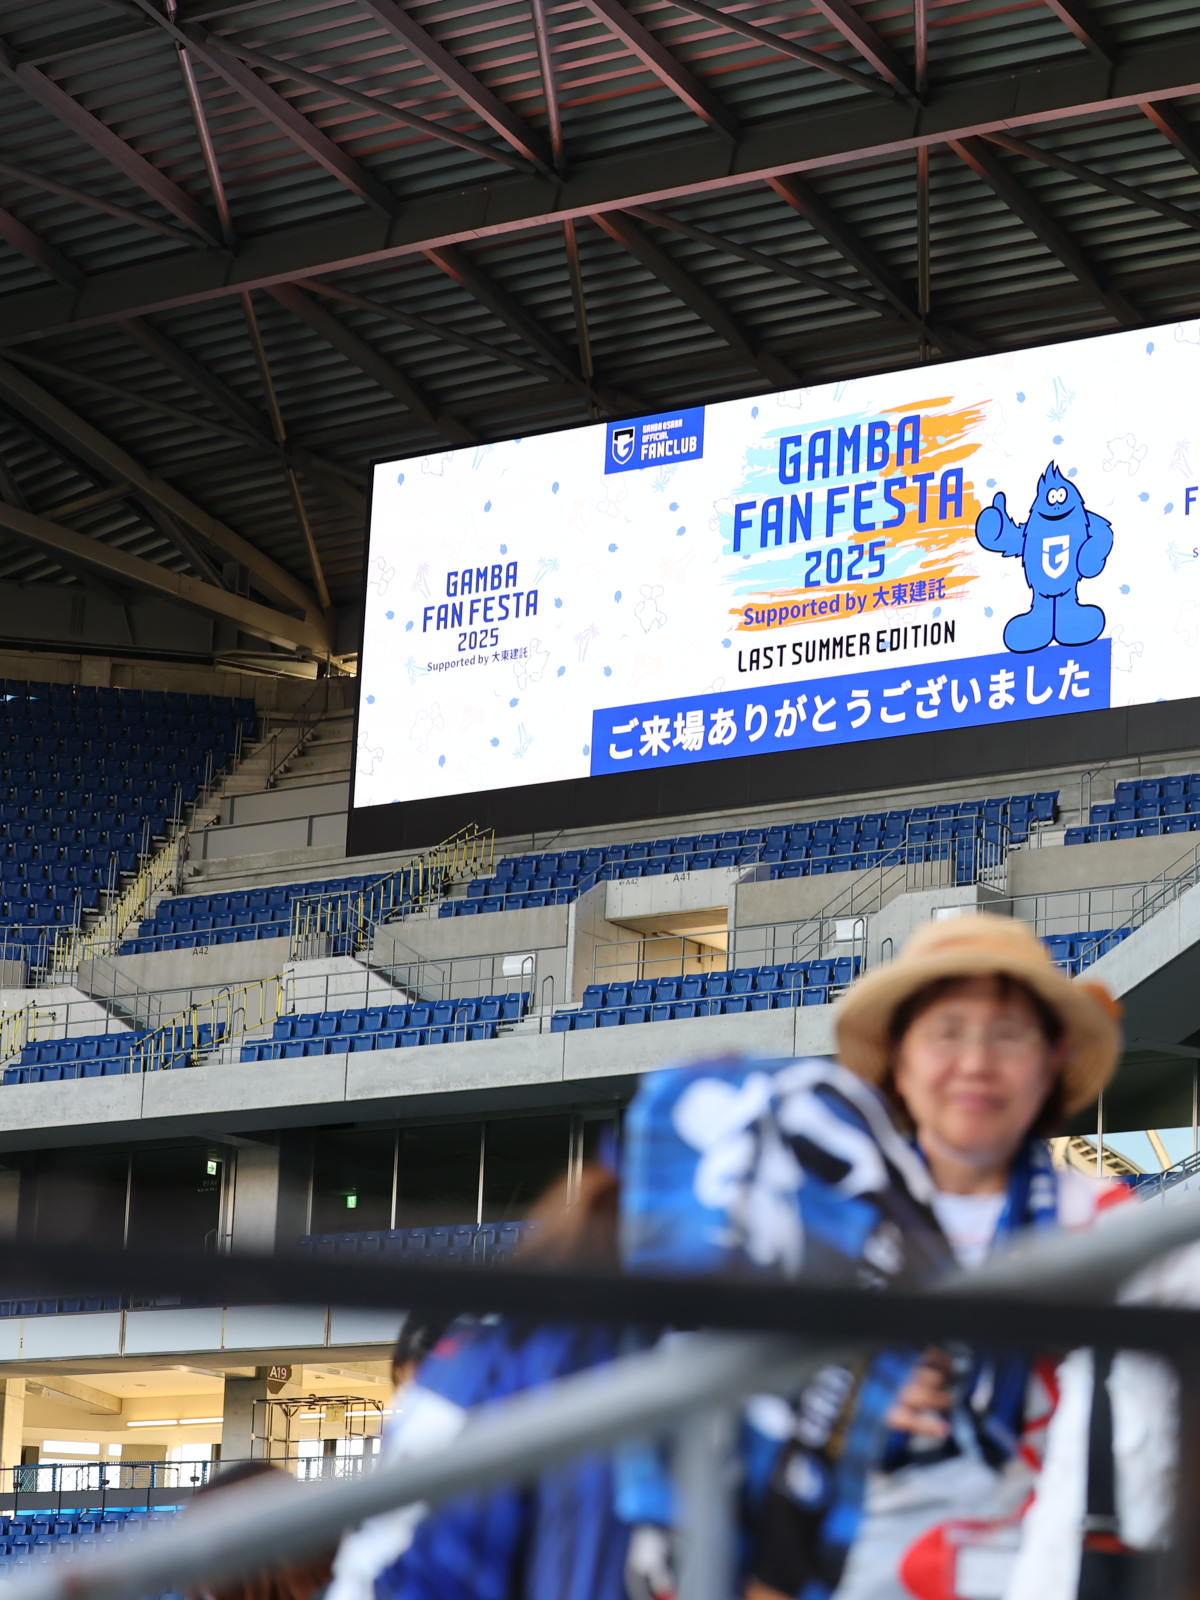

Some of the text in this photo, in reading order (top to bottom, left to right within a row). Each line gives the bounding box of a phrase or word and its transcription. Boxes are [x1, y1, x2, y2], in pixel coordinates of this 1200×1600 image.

[640, 436, 698, 461] FANCLUB
[641, 431, 669, 443] OFFICIAL
[779, 414, 921, 485] GAMBA
[733, 467, 964, 553] FAN FESTA
[446, 561, 518, 598] GAMBA
[804, 540, 886, 588] 2025
[422, 589, 539, 633] FAN FESTA
[743, 576, 946, 627] Supported by 大東建託
[458, 627, 499, 652] 2025
[738, 619, 956, 673] LAST SUMMER EDITION
[427, 646, 529, 672] Supported by 大東建託
[607, 658, 1091, 761] ご来場ありがとうございました
[673, 872, 691, 882] A41
[193, 947, 209, 956] A42
[269, 1366, 287, 1380] A19
